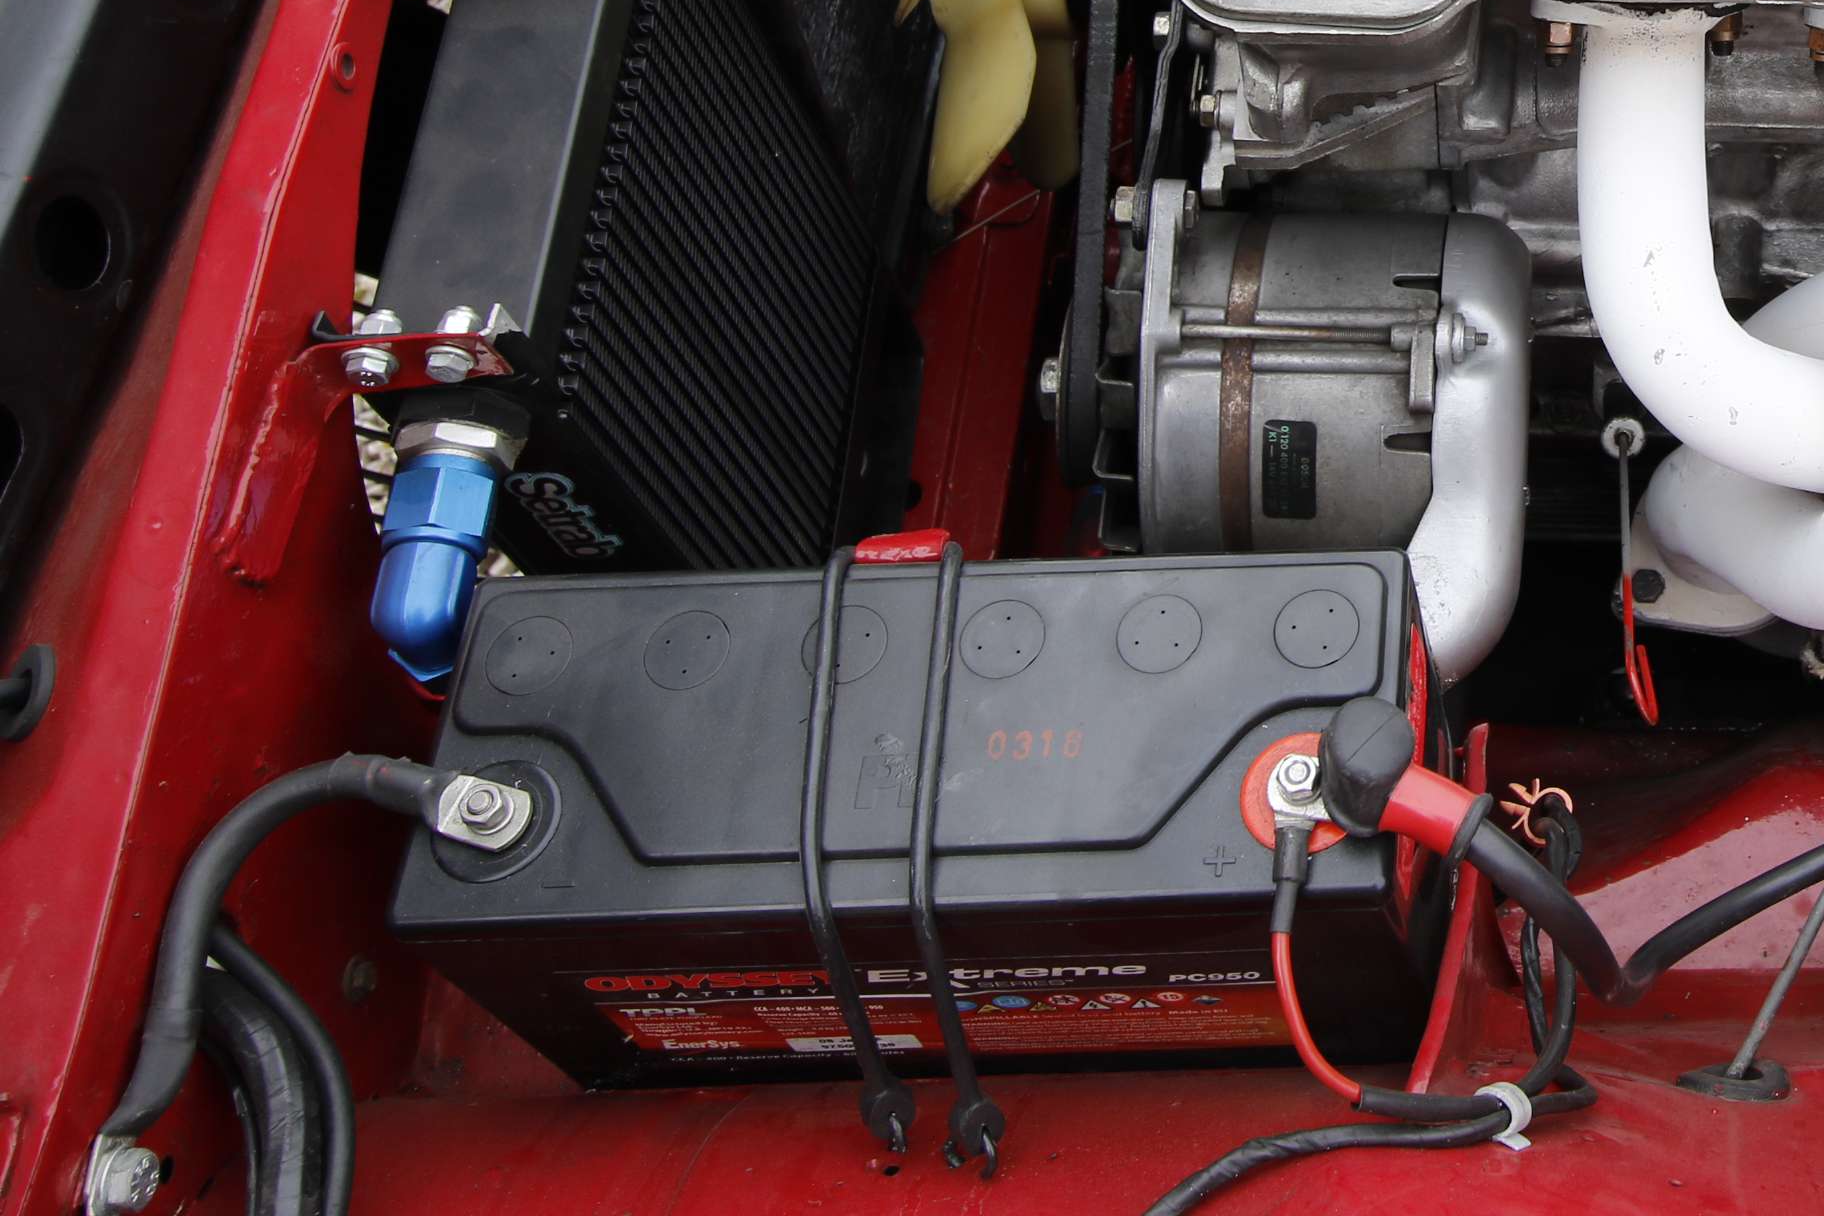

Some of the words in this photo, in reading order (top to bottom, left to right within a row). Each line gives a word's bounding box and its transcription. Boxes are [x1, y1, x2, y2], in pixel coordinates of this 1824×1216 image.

[505, 472, 624, 559] Setrab
[1168, 971, 1260, 982] PC950
[647, 987, 819, 999] BATTERY
[661, 1037, 741, 1051] EnerSys
